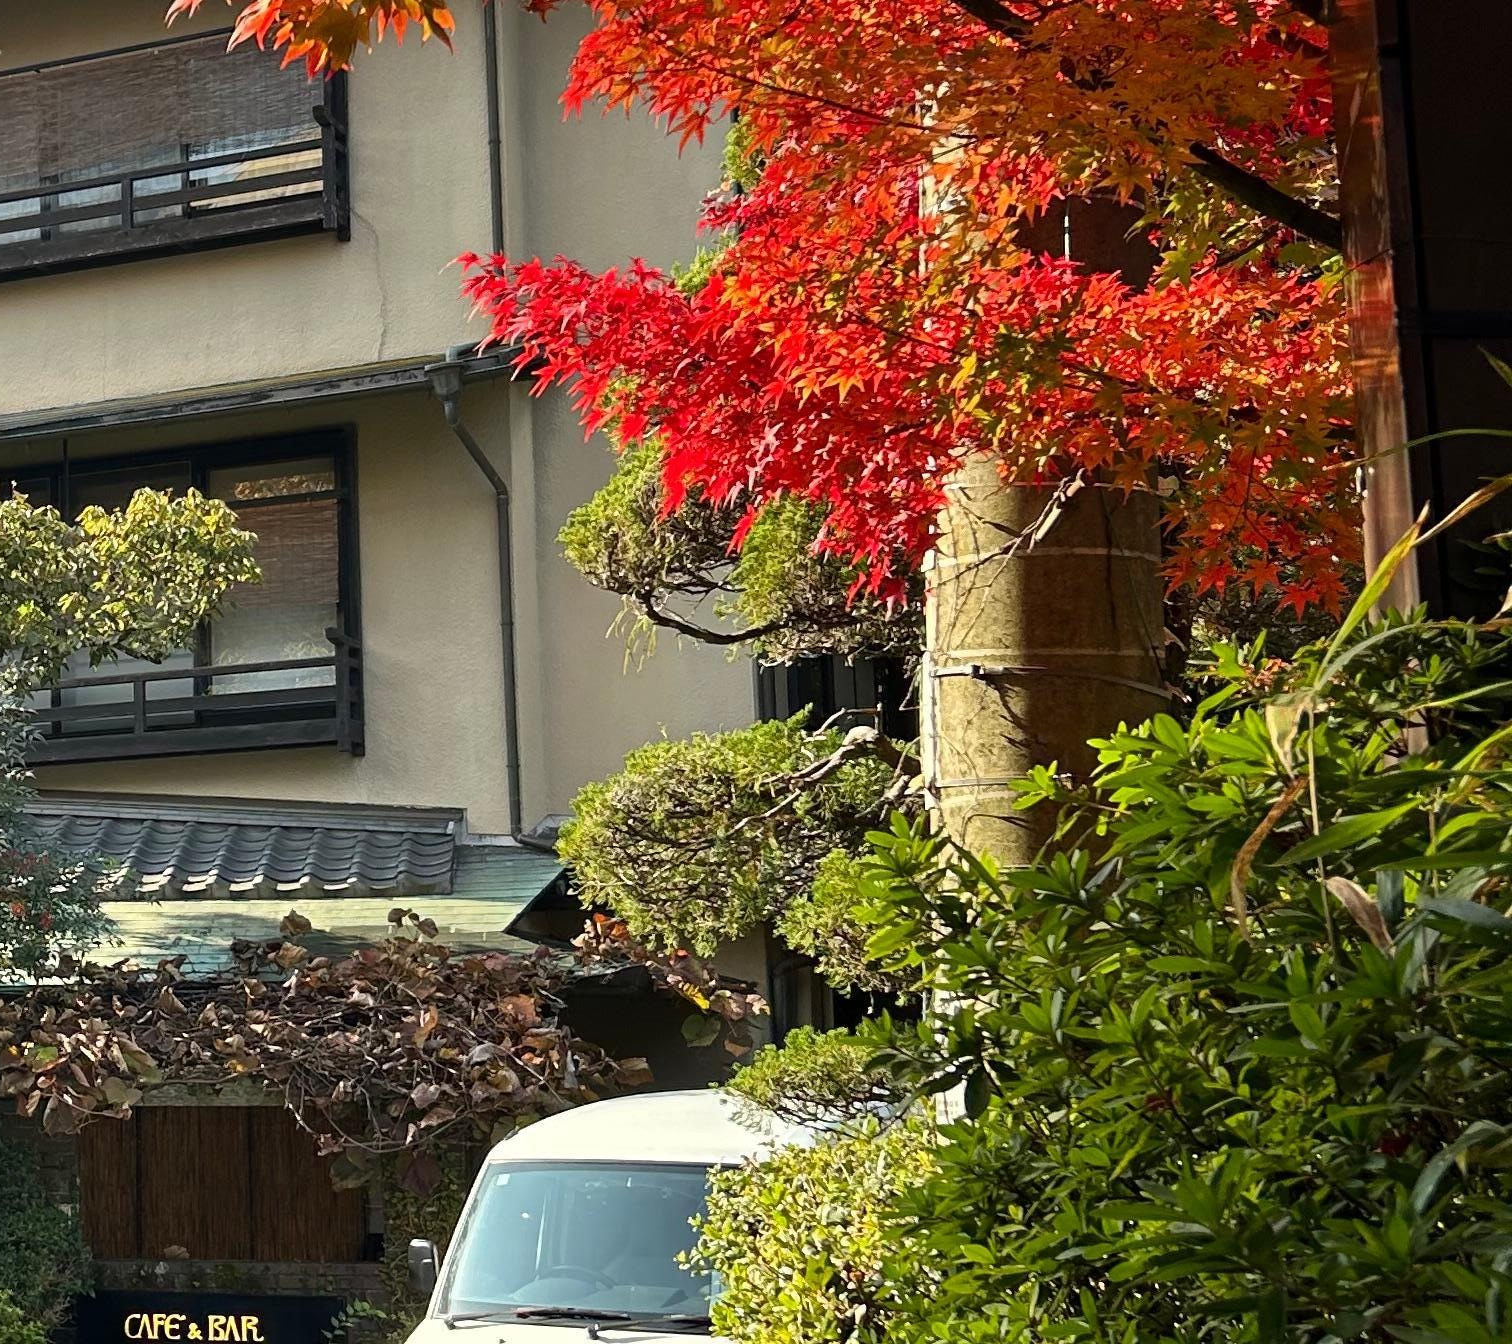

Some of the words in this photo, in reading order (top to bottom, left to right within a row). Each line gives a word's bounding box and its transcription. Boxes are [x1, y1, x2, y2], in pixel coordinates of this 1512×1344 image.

[124, 1313, 187, 1340] CAFE
[187, 1322, 203, 1341] &
[207, 1314, 265, 1342] BAR
